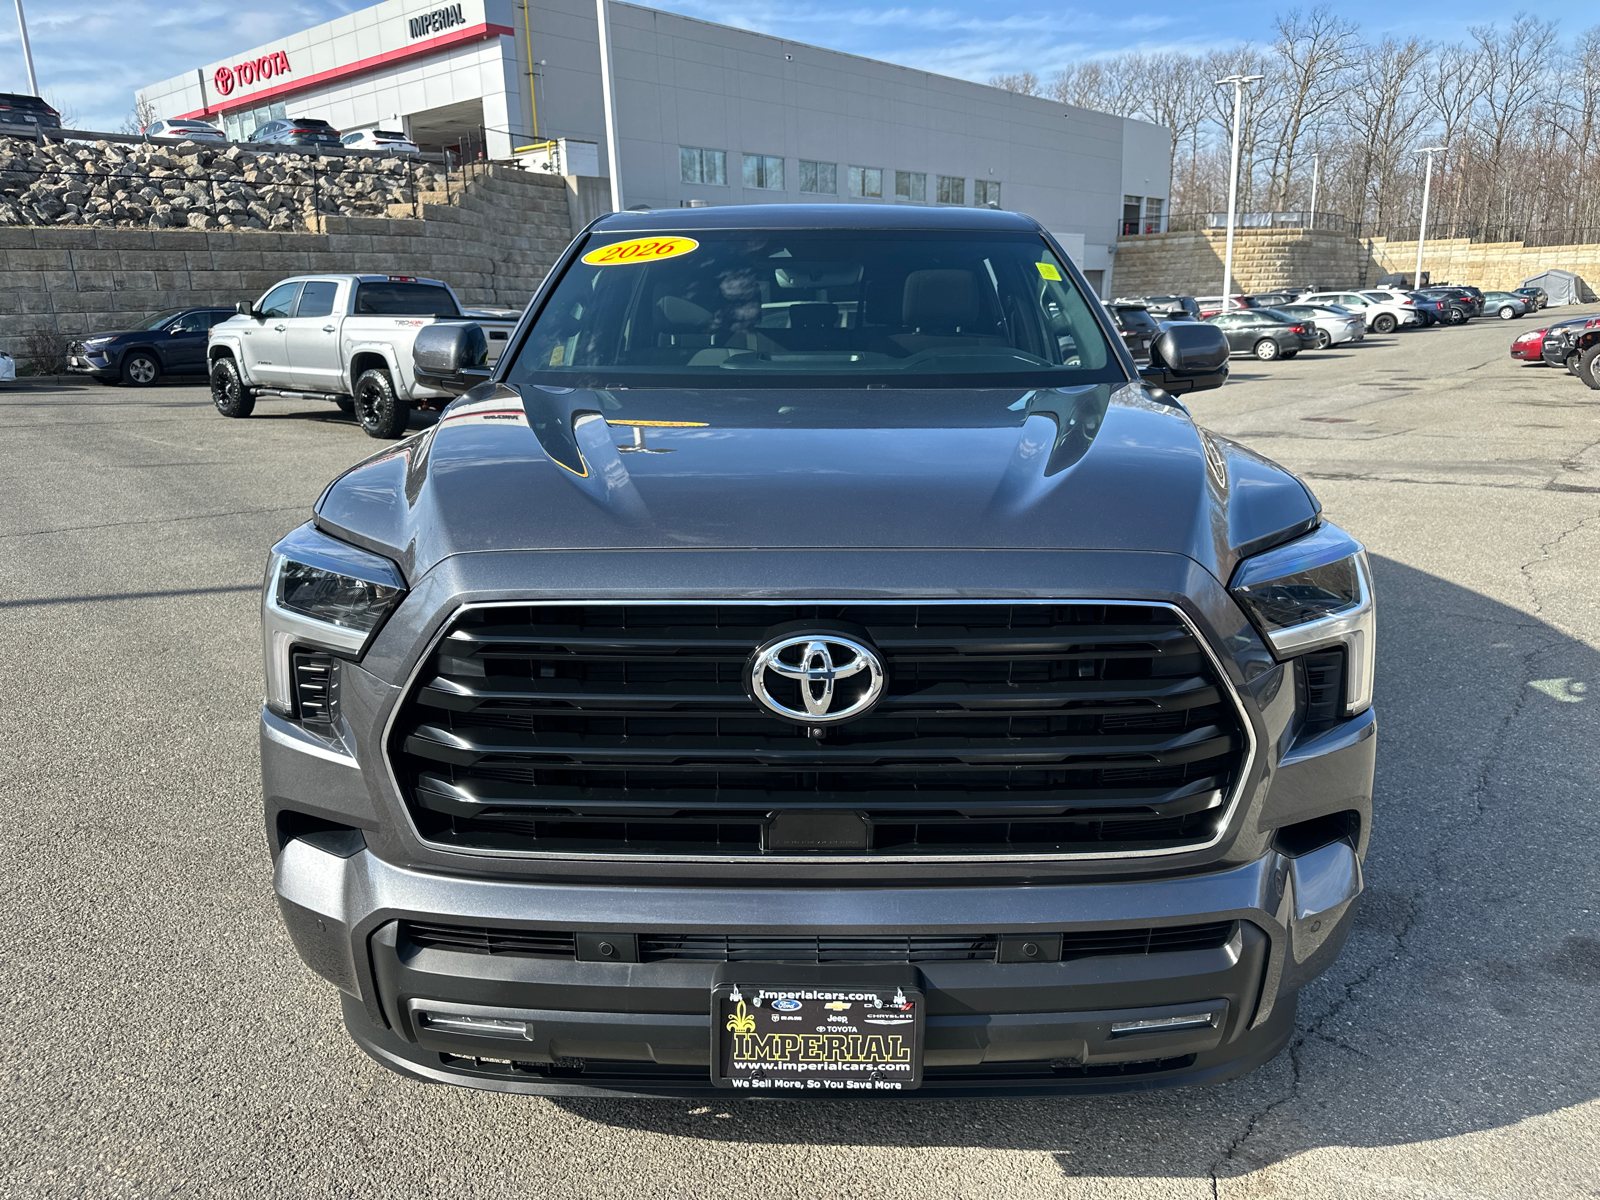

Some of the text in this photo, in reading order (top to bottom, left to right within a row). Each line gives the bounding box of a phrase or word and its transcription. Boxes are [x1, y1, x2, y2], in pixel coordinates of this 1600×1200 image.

[409, 3, 466, 39] IMPERIAL
[233, 50, 291, 87] TOYOTA
[598, 240, 681, 262] 2026
[758, 990, 877, 1001] Imperialcars.com
[778, 1001, 796, 1010] Ford
[827, 1014, 848, 1024] Jeep
[827, 1025, 858, 1033] TOYOTA
[733, 1032, 911, 1062] IMPERIAL
[733, 1061, 911, 1072] www.imperialcars.com
[732, 1079, 902, 1090] We Sell More, So You Save More
